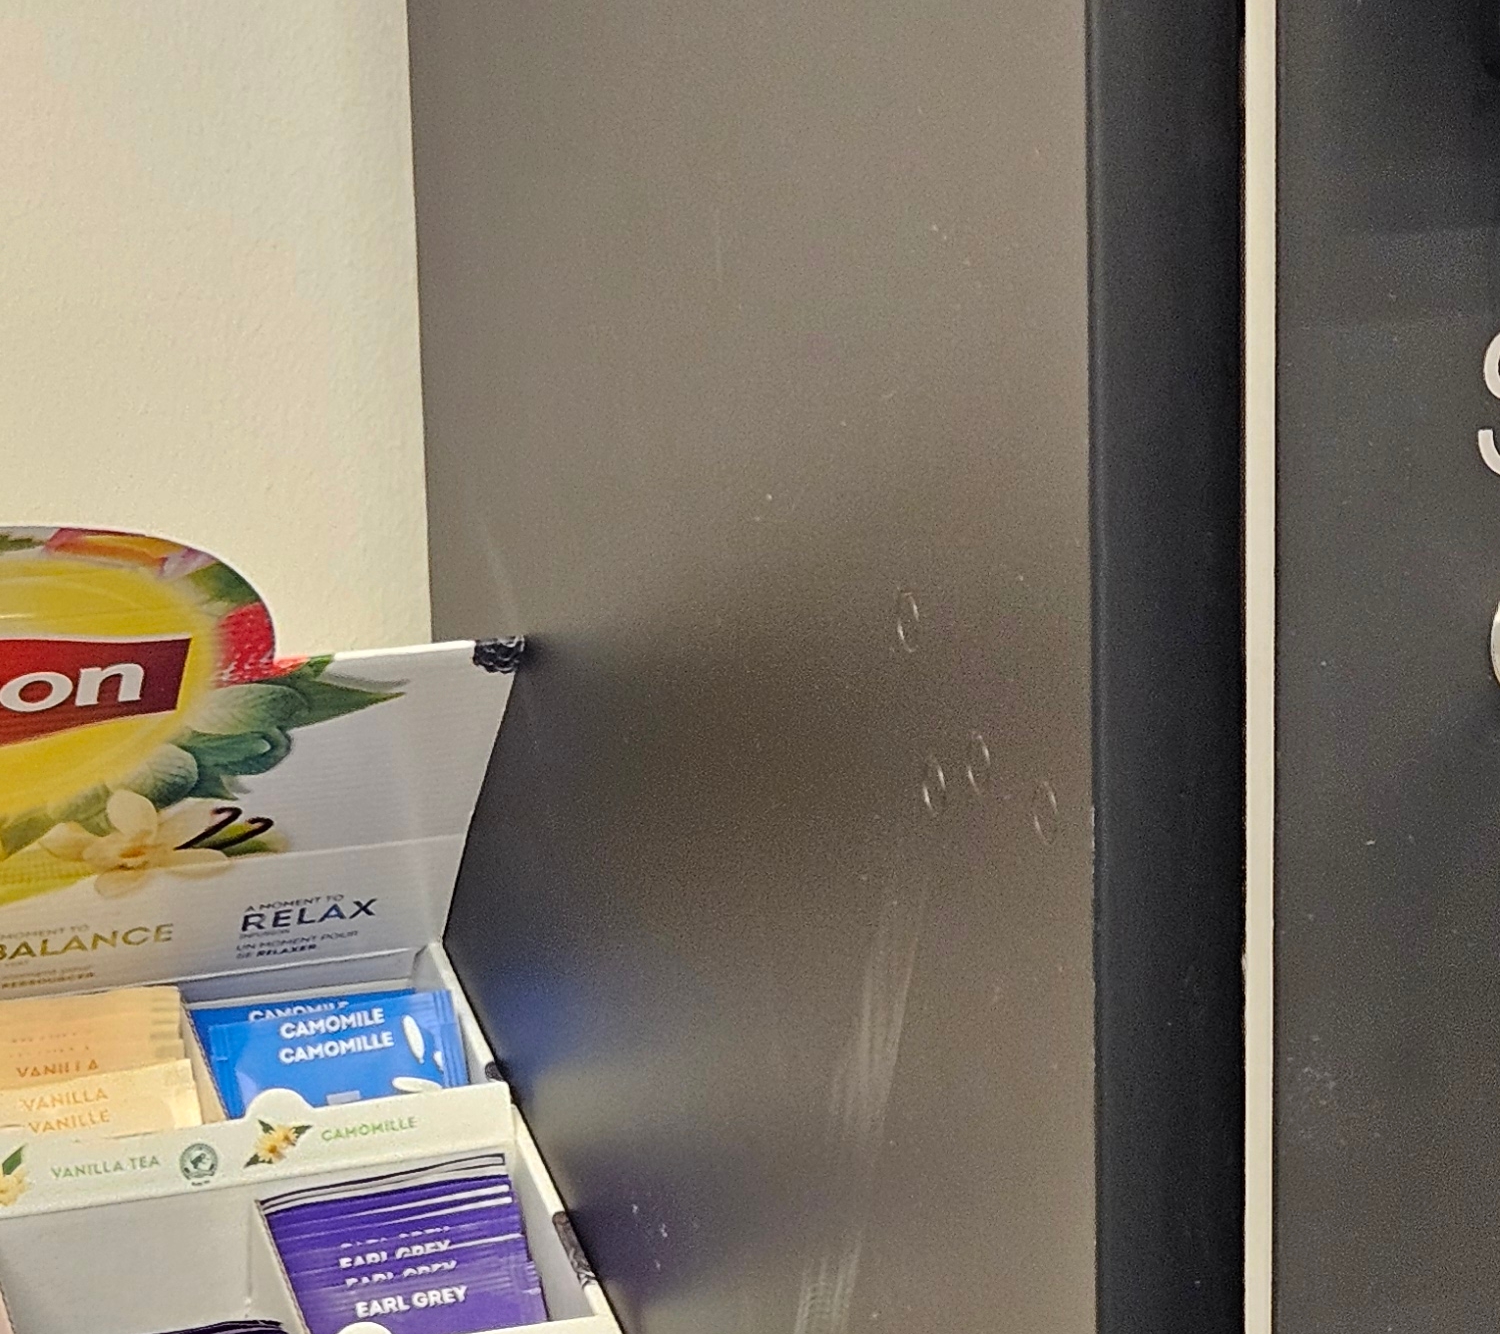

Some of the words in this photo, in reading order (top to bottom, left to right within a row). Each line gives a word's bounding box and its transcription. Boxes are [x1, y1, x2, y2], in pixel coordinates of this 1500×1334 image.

[0, 663, 145, 713] on
[241, 898, 377, 931] RELAX
[259, 897, 321, 910] MOMENT
[326, 894, 344, 902] TO
[279, 1007, 385, 1040] CAMOMILE
[278, 1031, 395, 1064] CAMOMILLE
[20, 1087, 109, 1112] VANILLA
[28, 1108, 111, 1134] VANILLE
[321, 1117, 418, 1142] CAMOMILLE
[51, 1160, 126, 1179] VANILLA
[129, 1155, 160, 1172] TEA
[355, 1296, 410, 1318] EARL
[411, 1285, 468, 1308] GREY
